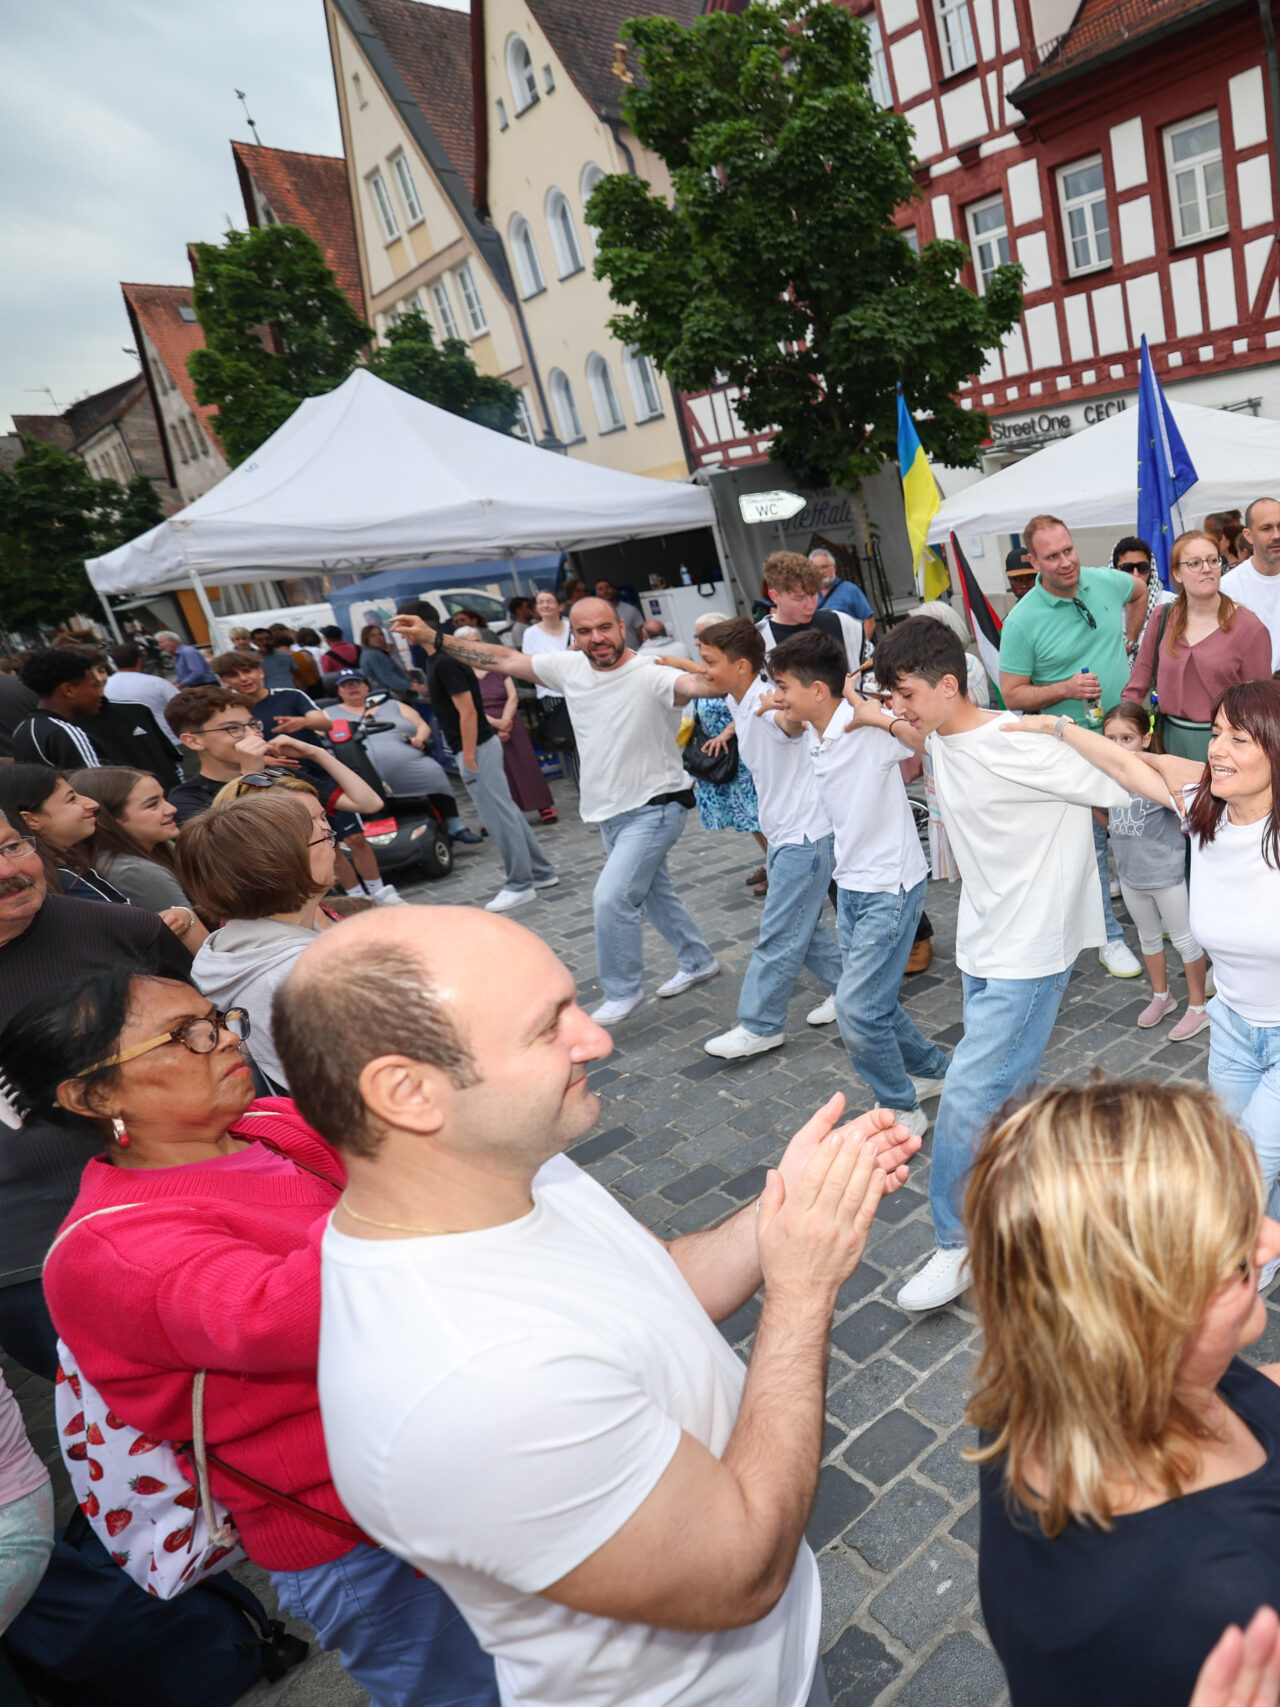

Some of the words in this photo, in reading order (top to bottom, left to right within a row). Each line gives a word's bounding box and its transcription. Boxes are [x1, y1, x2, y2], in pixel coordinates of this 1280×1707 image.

[991, 416, 1036, 440] Street
[1038, 414, 1071, 432] One
[755, 504, 779, 517] WC
